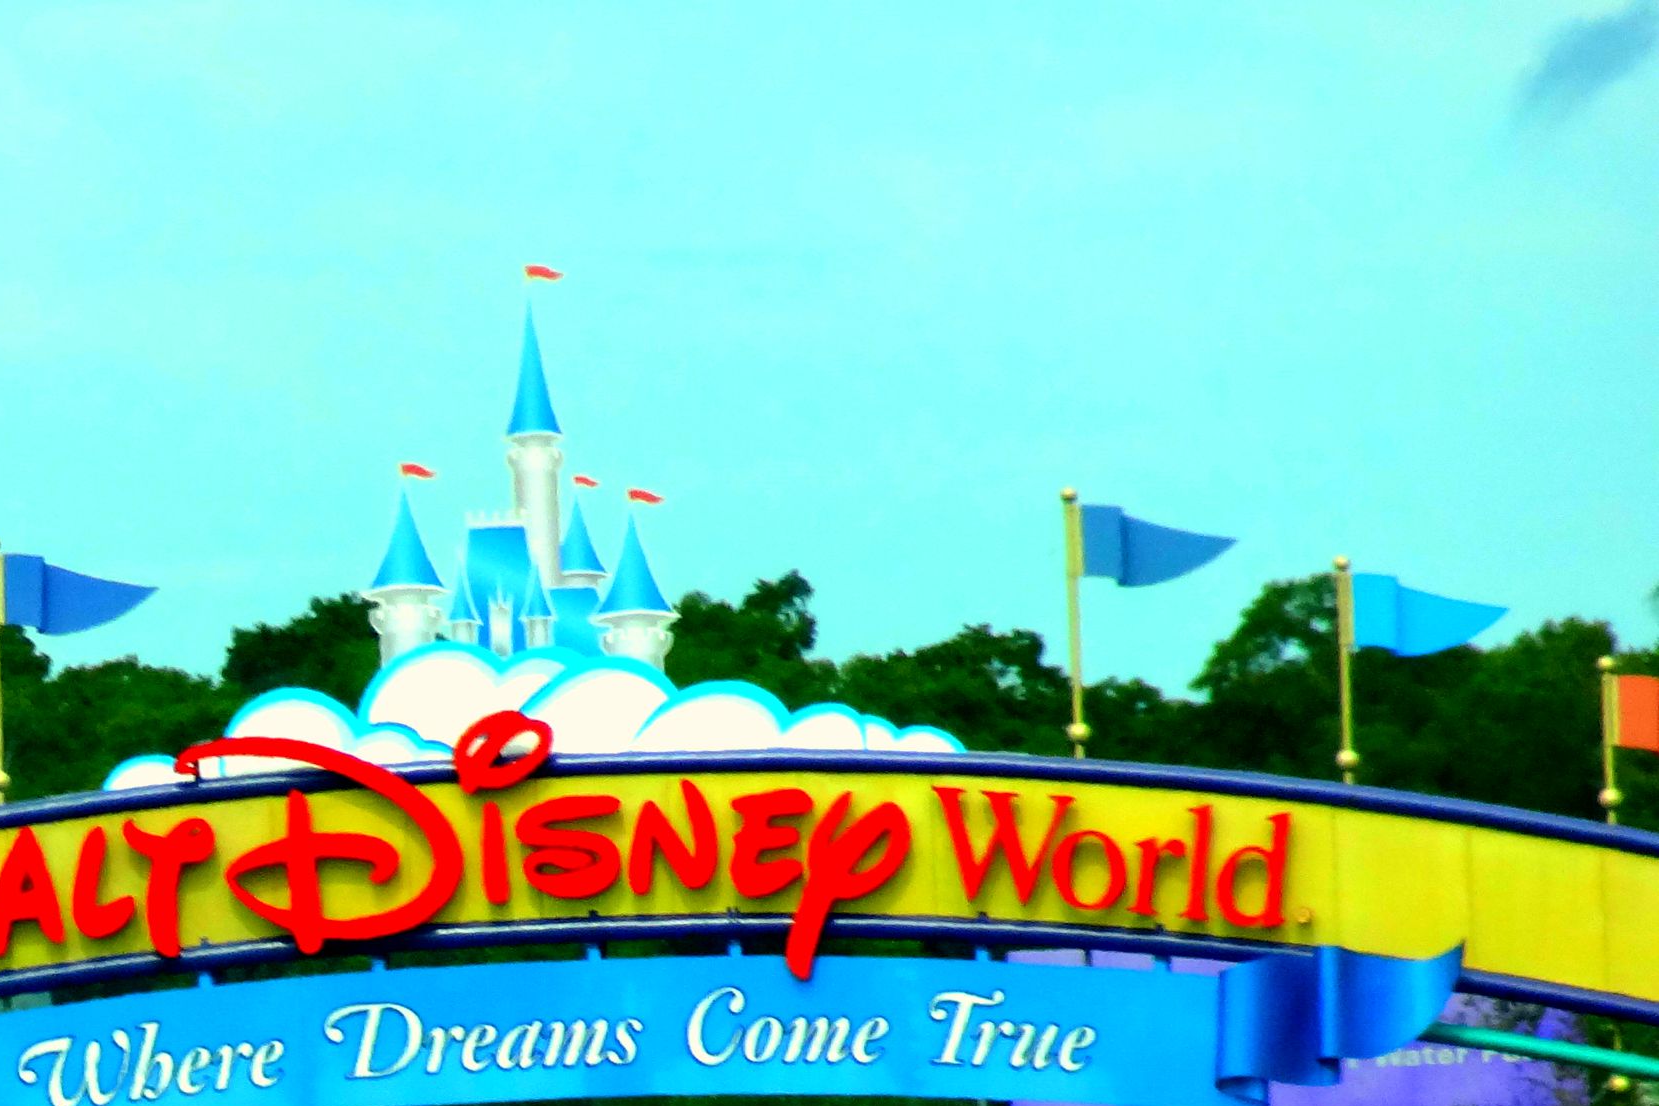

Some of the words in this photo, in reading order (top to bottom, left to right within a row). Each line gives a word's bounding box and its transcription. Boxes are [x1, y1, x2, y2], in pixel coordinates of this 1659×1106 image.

[931, 785, 1290, 929] World
[323, 1002, 644, 1079] Dreams
[686, 986, 890, 1066] Come
[928, 990, 1097, 1073] True
